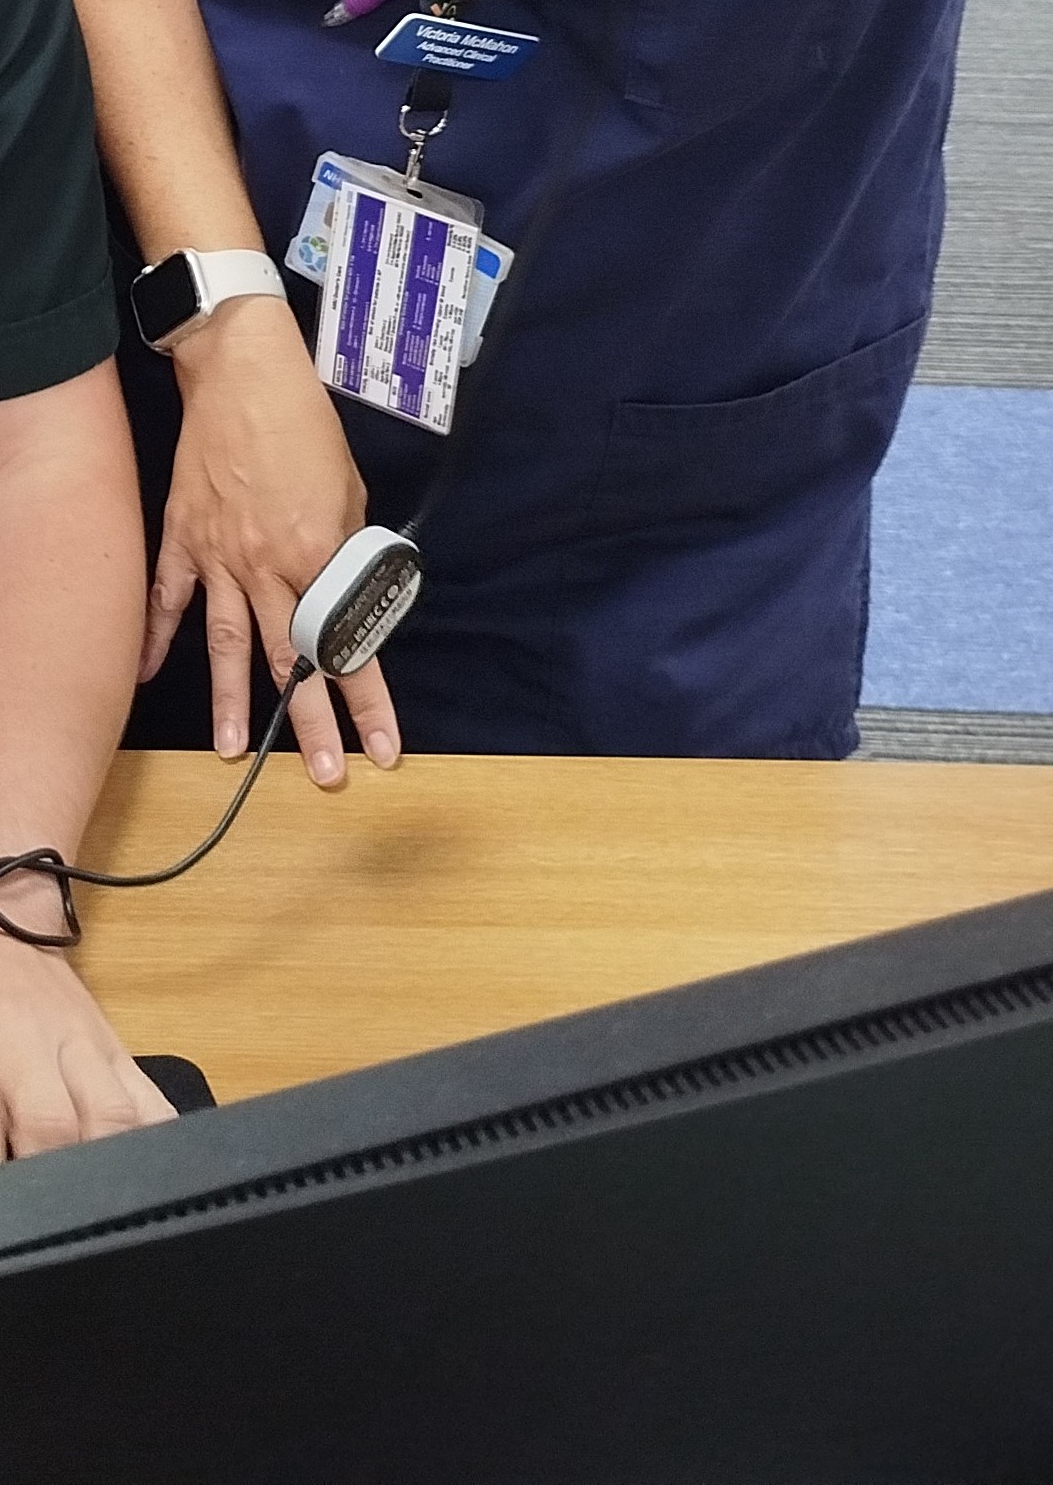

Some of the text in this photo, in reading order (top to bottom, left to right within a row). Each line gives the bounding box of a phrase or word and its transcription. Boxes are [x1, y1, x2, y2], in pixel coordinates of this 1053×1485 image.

[416, 25, 518, 55] Victoria McMahon
[416, 41, 497, 63] Advanced Clinical
[422, 54, 474, 70] Practitioner
[322, 168, 343, 184] NH
